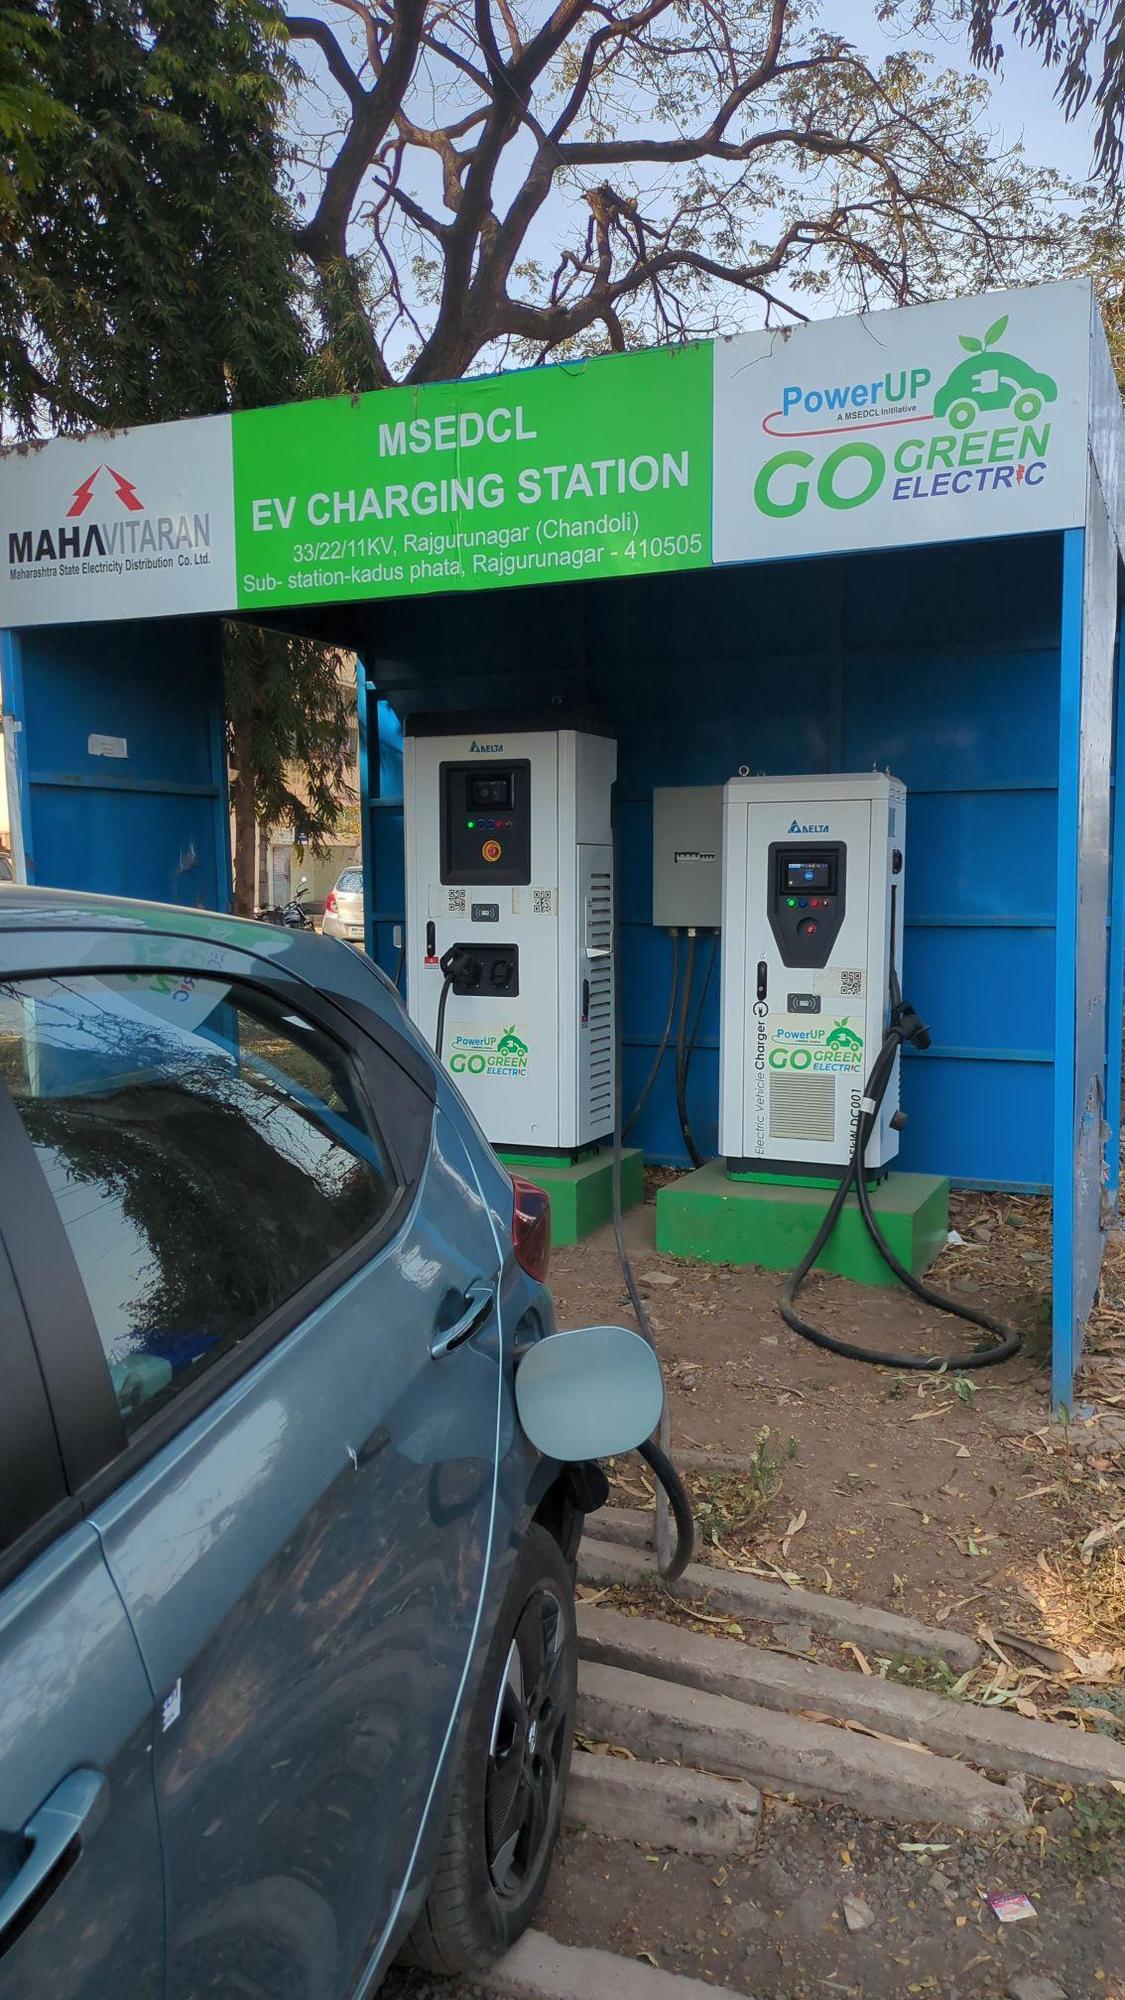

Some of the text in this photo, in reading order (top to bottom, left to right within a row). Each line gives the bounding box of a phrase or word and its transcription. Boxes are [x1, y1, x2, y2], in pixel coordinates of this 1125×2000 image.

[782, 368, 931, 416] PowerUP
[837, 413, 843, 421] A
[845, 409, 879, 420] MSEDCL
[379, 406, 537, 457] MSEDCL
[893, 423, 1052, 473] GREEN
[754, 442, 885, 518] GO
[252, 451, 689, 532] EV CHARGING STATION
[293, 511, 639, 564] 33/22/11KV, Rajgurunagar (Chandoli)
[10, 552, 211, 580] Maharashtra State Electricity Distribution Co. Ltd.
[243, 573, 283, 593] Sub-
[288, 563, 404, 590] station-kadus
[409, 559, 466, 583] phata,
[473, 547, 604, 576] Rajgurunagar
[624, 534, 702, 560] 410505
[803, 825, 829, 833] DELTA
[456, 1036, 496, 1045] PowerUP
[777, 1029, 825, 1039] PowerUP
[450, 1054, 486, 1074] GO
[487, 1056, 527, 1067] GREEN
[769, 1048, 812, 1070] GO
[813, 1051, 862, 1063] GREEN
[813, 1063, 861, 1072] ELECTRIC
[487, 1067, 526, 1076] ELECTRIC
[755, 1021, 767, 1154] Electric Vehicle Charger
